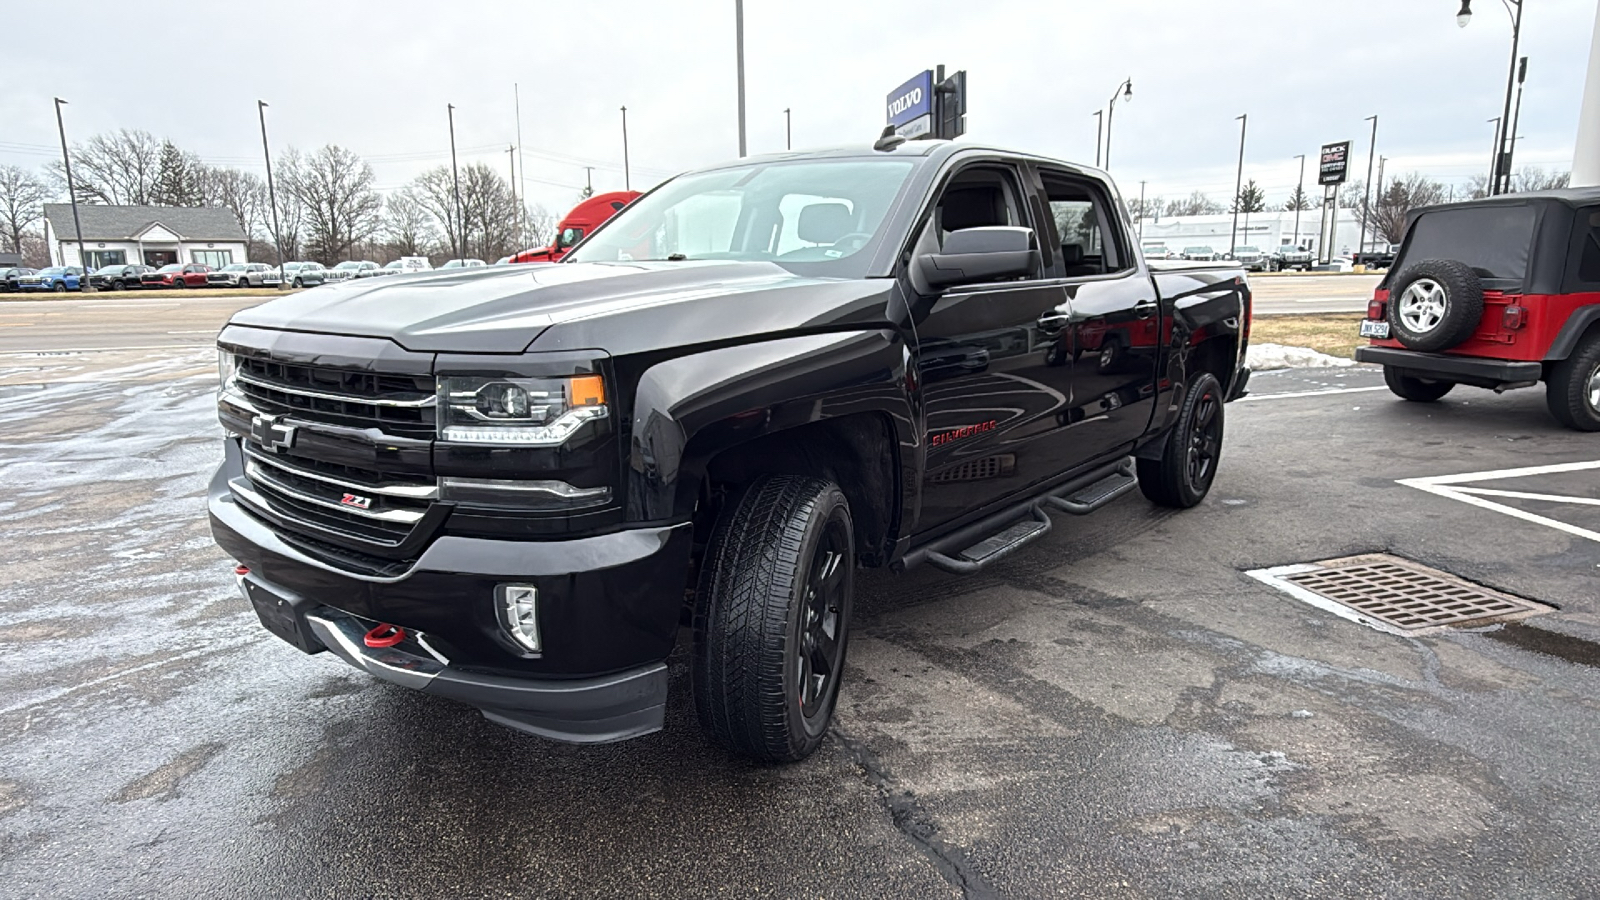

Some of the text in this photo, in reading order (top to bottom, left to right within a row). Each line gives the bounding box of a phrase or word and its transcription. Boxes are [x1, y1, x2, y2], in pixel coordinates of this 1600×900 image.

[888, 87, 921, 118] VOLVO
[1322, 145, 1345, 154] BUICK
[1322, 152, 1344, 162] GMC
[932, 420, 996, 446] SILVERADO
[341, 493, 371, 509] Z71
